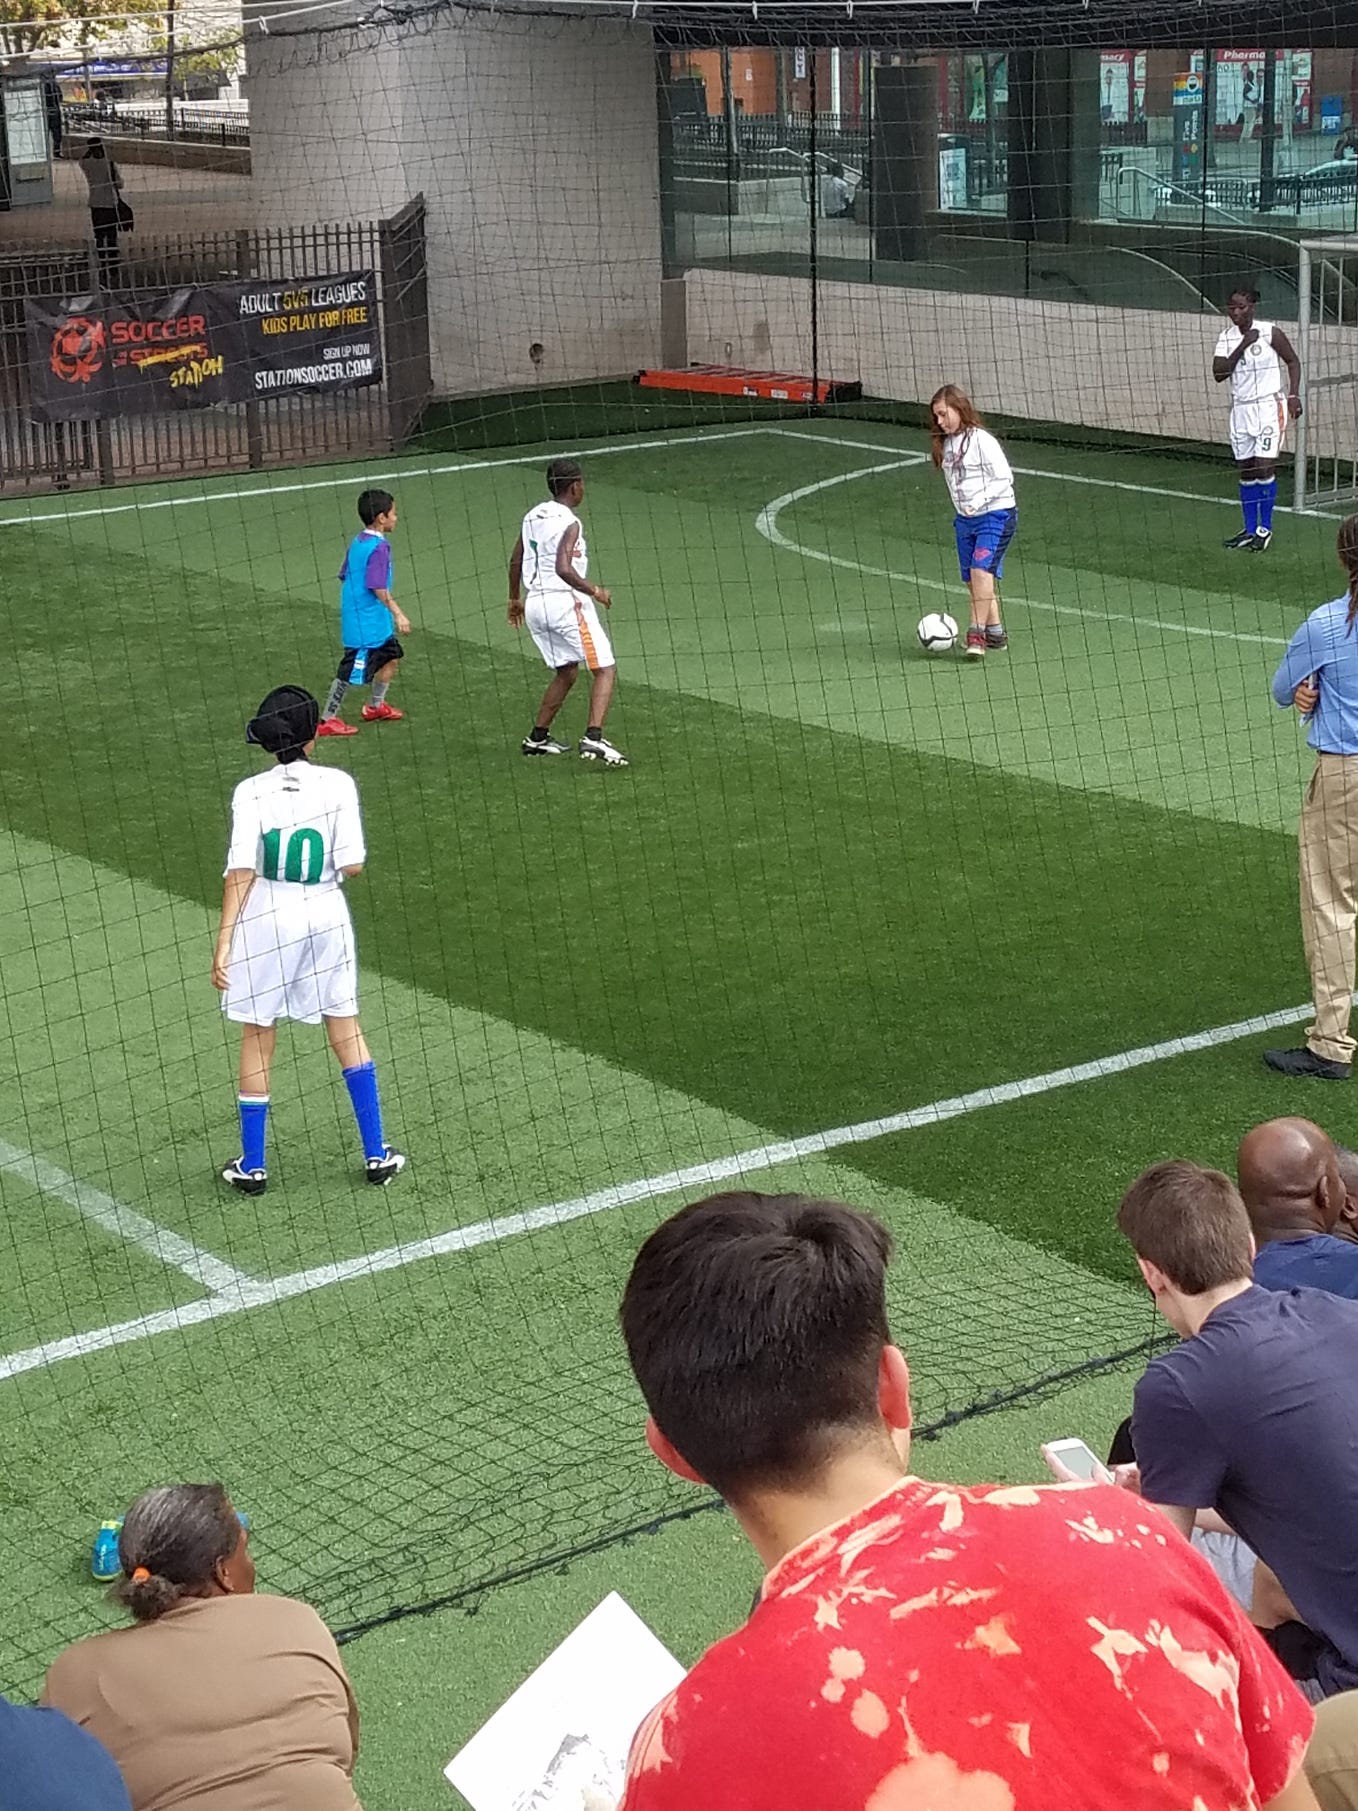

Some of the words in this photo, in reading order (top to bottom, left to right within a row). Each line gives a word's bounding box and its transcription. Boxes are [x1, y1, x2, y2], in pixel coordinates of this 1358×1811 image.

[240, 292, 282, 314] ADULT
[311, 281, 366, 307] LEAGUES
[111, 314, 206, 344] SOCCER
[262, 317, 288, 335] KIDS
[289, 312, 318, 332] PLAY
[319, 310, 340, 328] FOR
[341, 307, 368, 325] FREE
[323, 346, 341, 360] SIGN
[341, 345, 352, 358] UP
[352, 343, 370, 356] NOW
[255, 358, 373, 390] STATIONSOCCER.COM
[263, 827, 324, 886] 10
